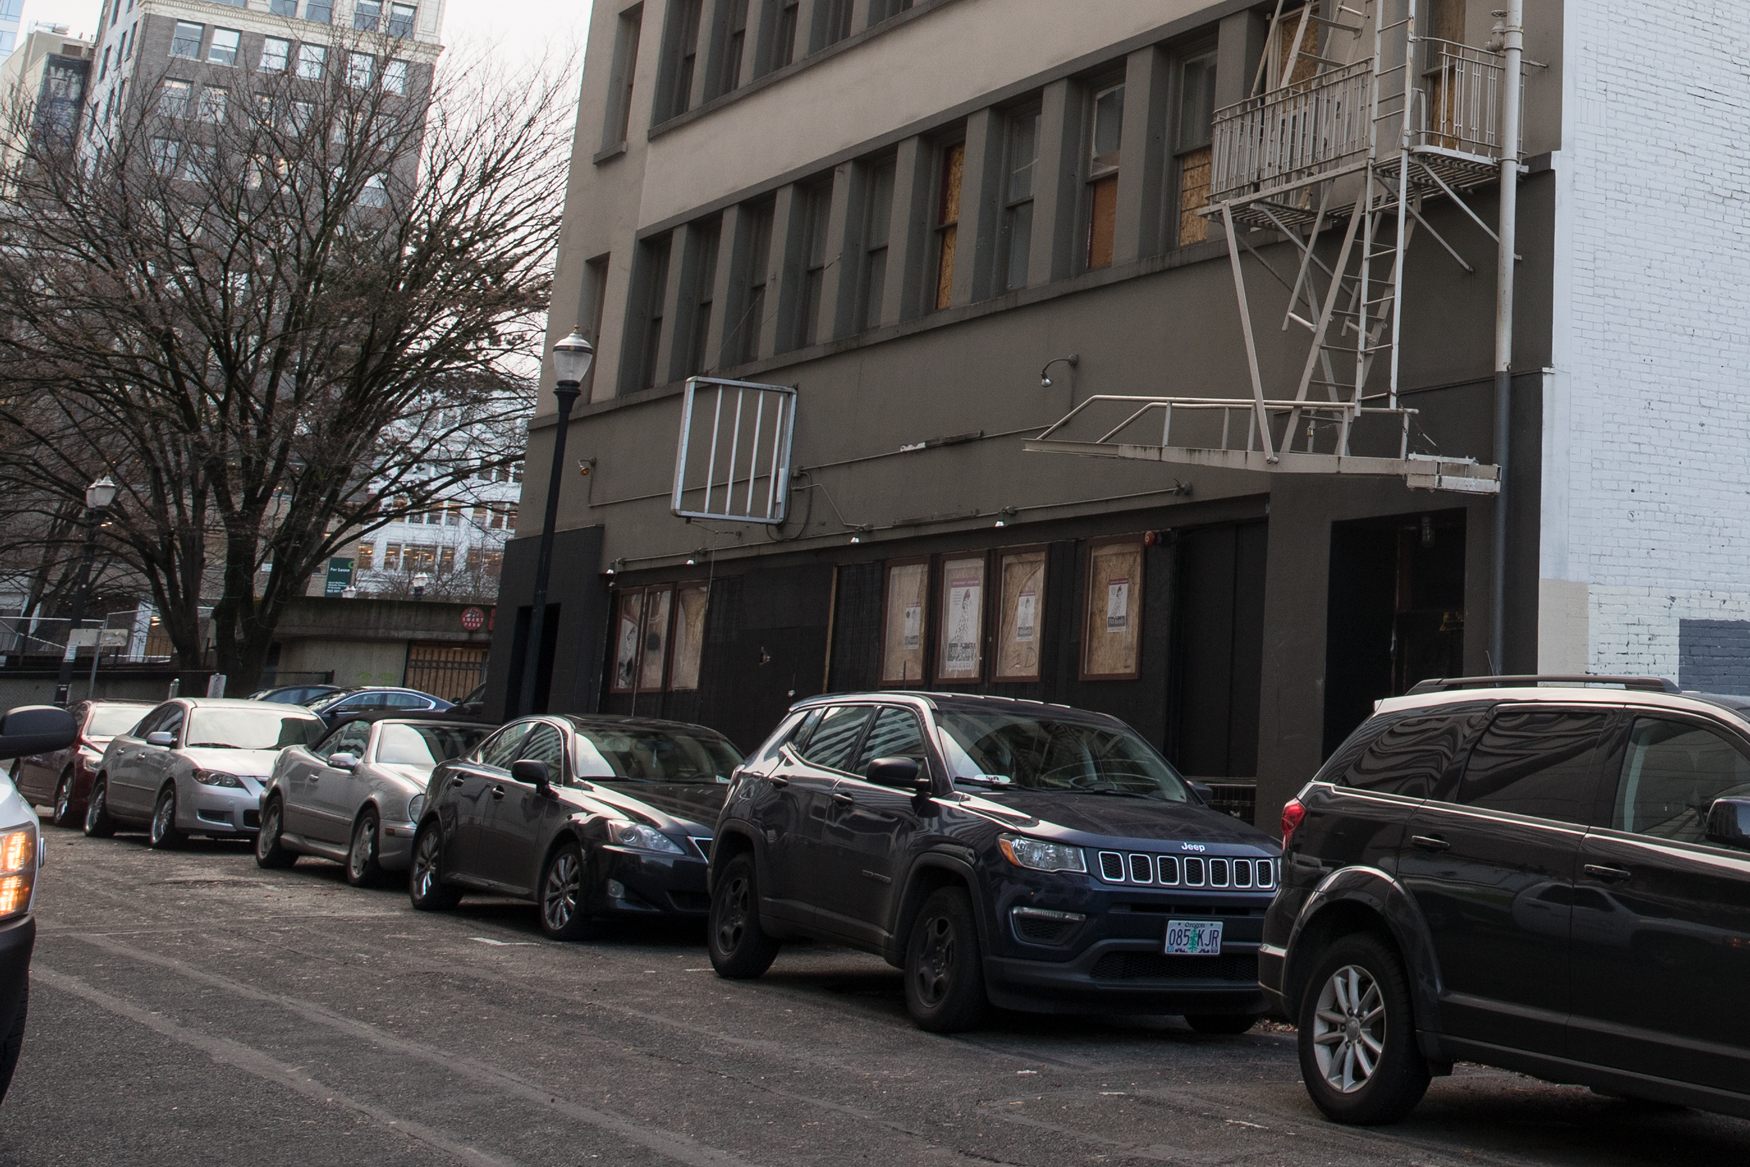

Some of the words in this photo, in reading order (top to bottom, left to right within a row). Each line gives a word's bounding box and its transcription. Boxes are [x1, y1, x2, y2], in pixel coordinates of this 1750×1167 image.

[1181, 842, 1206, 853] Jeep
[1184, 921, 1205, 929] Oregon
[1168, 929, 1191, 946] 085
[1197, 929, 1220, 947] KJR
